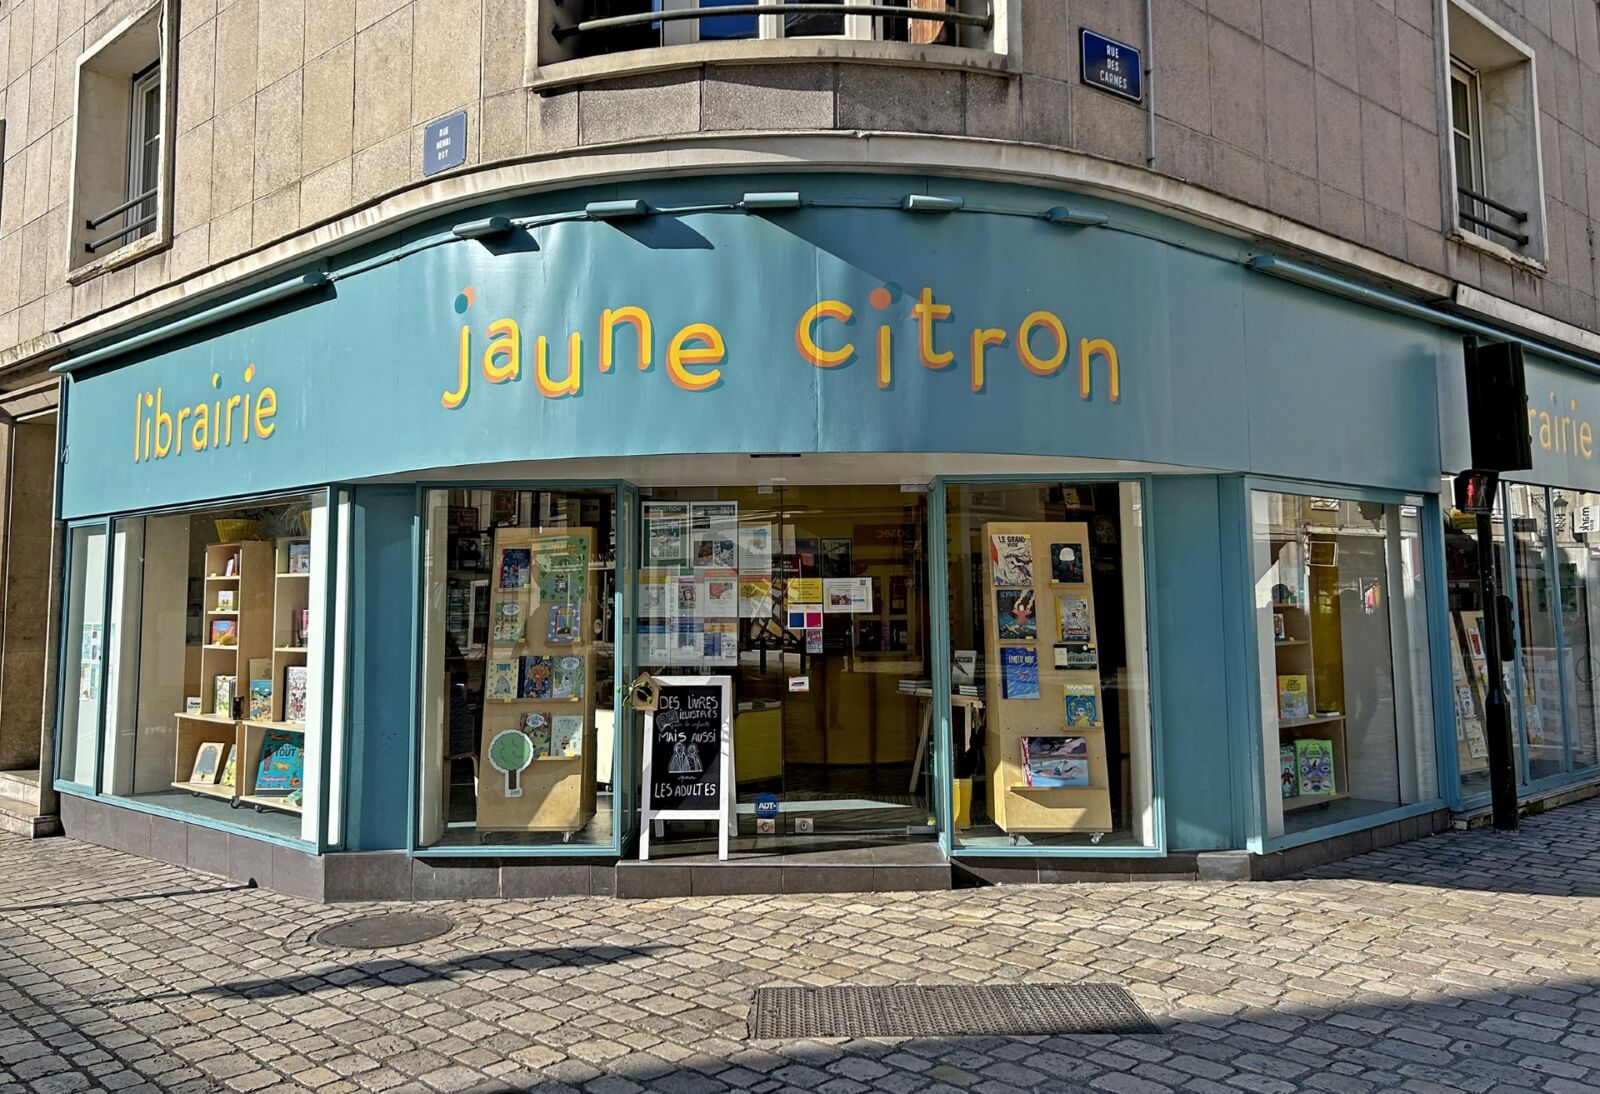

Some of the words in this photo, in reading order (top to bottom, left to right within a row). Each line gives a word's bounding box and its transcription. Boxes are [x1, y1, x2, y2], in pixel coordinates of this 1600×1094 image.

[1106, 45, 1119, 58] RUE
[1107, 58, 1119, 71] DES
[1099, 70, 1127, 89] CARMES
[439, 126, 448, 137] RUE
[440, 287, 728, 410] jaune
[795, 284, 1120, 403] citron
[134, 363, 277, 464] librairie
[1528, 391, 1593, 459] rairie
[998, 535, 1006, 543] LE
[1007, 535, 1027, 543] GRAND
[659, 695, 680, 710] DES
[275, 748, 297, 757] TOUT
[654, 783, 673, 799] LES
[674, 782, 716, 797] ADULTES
